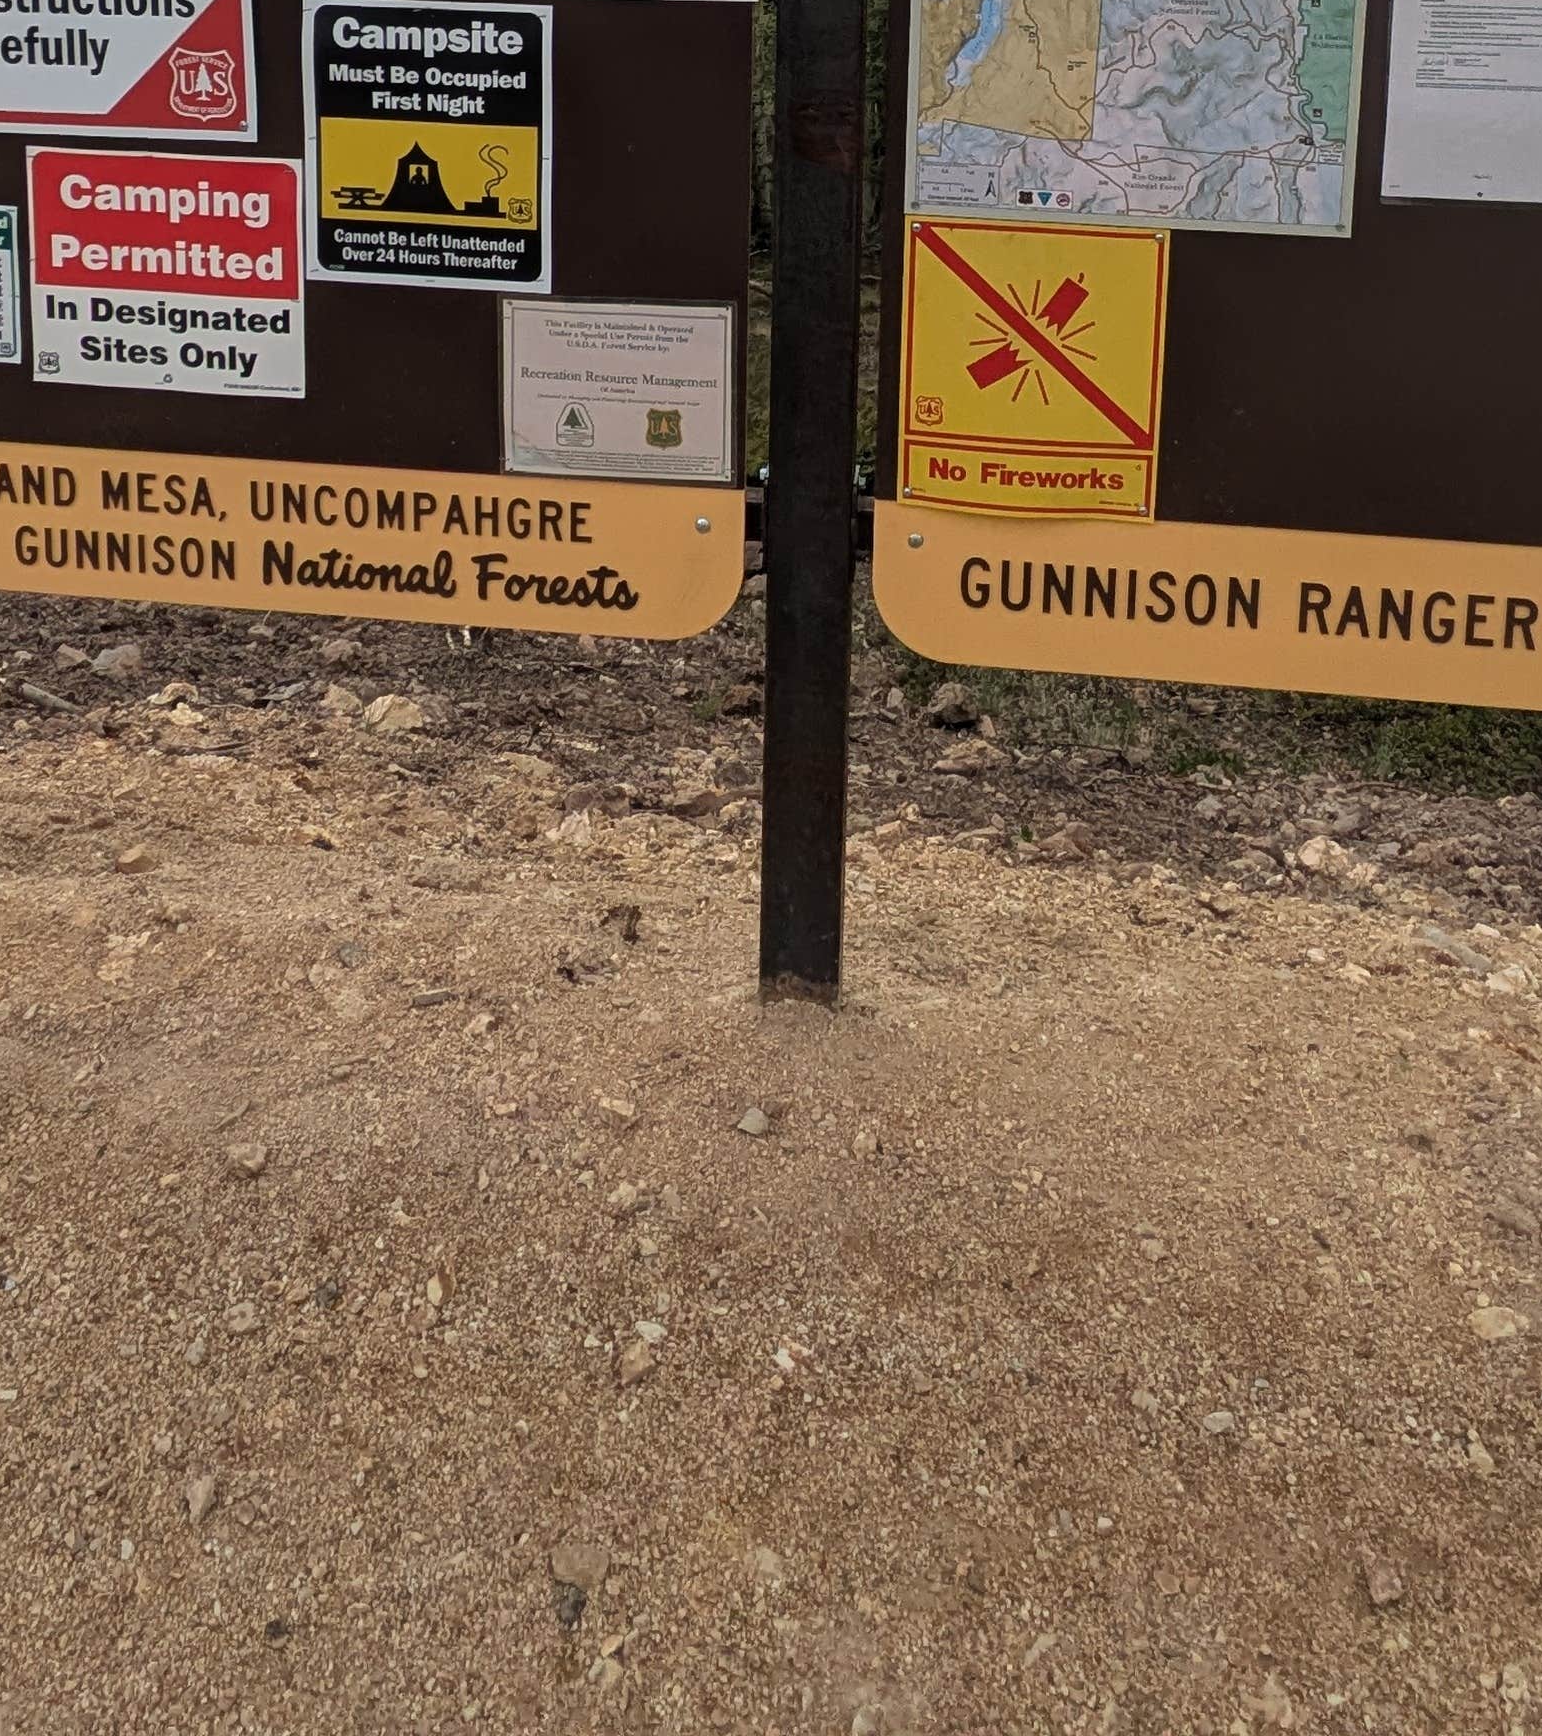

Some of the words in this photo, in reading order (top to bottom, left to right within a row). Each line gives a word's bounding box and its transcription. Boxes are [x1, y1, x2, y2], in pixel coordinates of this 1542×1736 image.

[332, 16, 523, 58] Campsite
[328, 64, 384, 83] Must
[390, 66, 419, 85] Be
[425, 69, 526, 91] Occupied
[372, 91, 421, 112] First
[427, 94, 485, 117] Night
[59, 175, 270, 230] Camping
[50, 233, 285, 282] Permitted
[333, 228, 385, 246] Cannot
[388, 232, 407, 247] Be
[410, 232, 438, 249] Left
[441, 234, 525, 254] Unattended
[342, 247, 373, 263] Over
[376, 248, 396, 264] 24
[399, 249, 440, 267] Hours
[443, 251, 518, 271] Thereafter
[45, 295, 77, 321] In
[91, 298, 291, 335] Designated
[563, 321, 591, 331] Facility
[657, 325, 694, 335] Operated
[549, 329, 573, 338] Under
[580, 331, 607, 341] Special
[610, 333, 624, 341] Use
[676, 335, 688, 343] the
[628, 343, 656, 351] Service
[80, 336, 168, 365] Sites
[179, 342, 258, 378] Only
[520, 367, 581, 382] Recreation
[585, 371, 638, 385] Resource
[642, 374, 717, 389] Management
[928, 457, 967, 482] No
[980, 462, 1124, 490] Fireworks
[101, 469, 229, 523] MESA,
[249, 480, 593, 545] UNCOMPAHGRE
[14, 524, 236, 583] GUNNISON
[262, 539, 458, 598] National
[473, 553, 640, 613] Forests
[959, 554, 1260, 630] GUNNISON
[1297, 580, 1541, 653] RANGER
